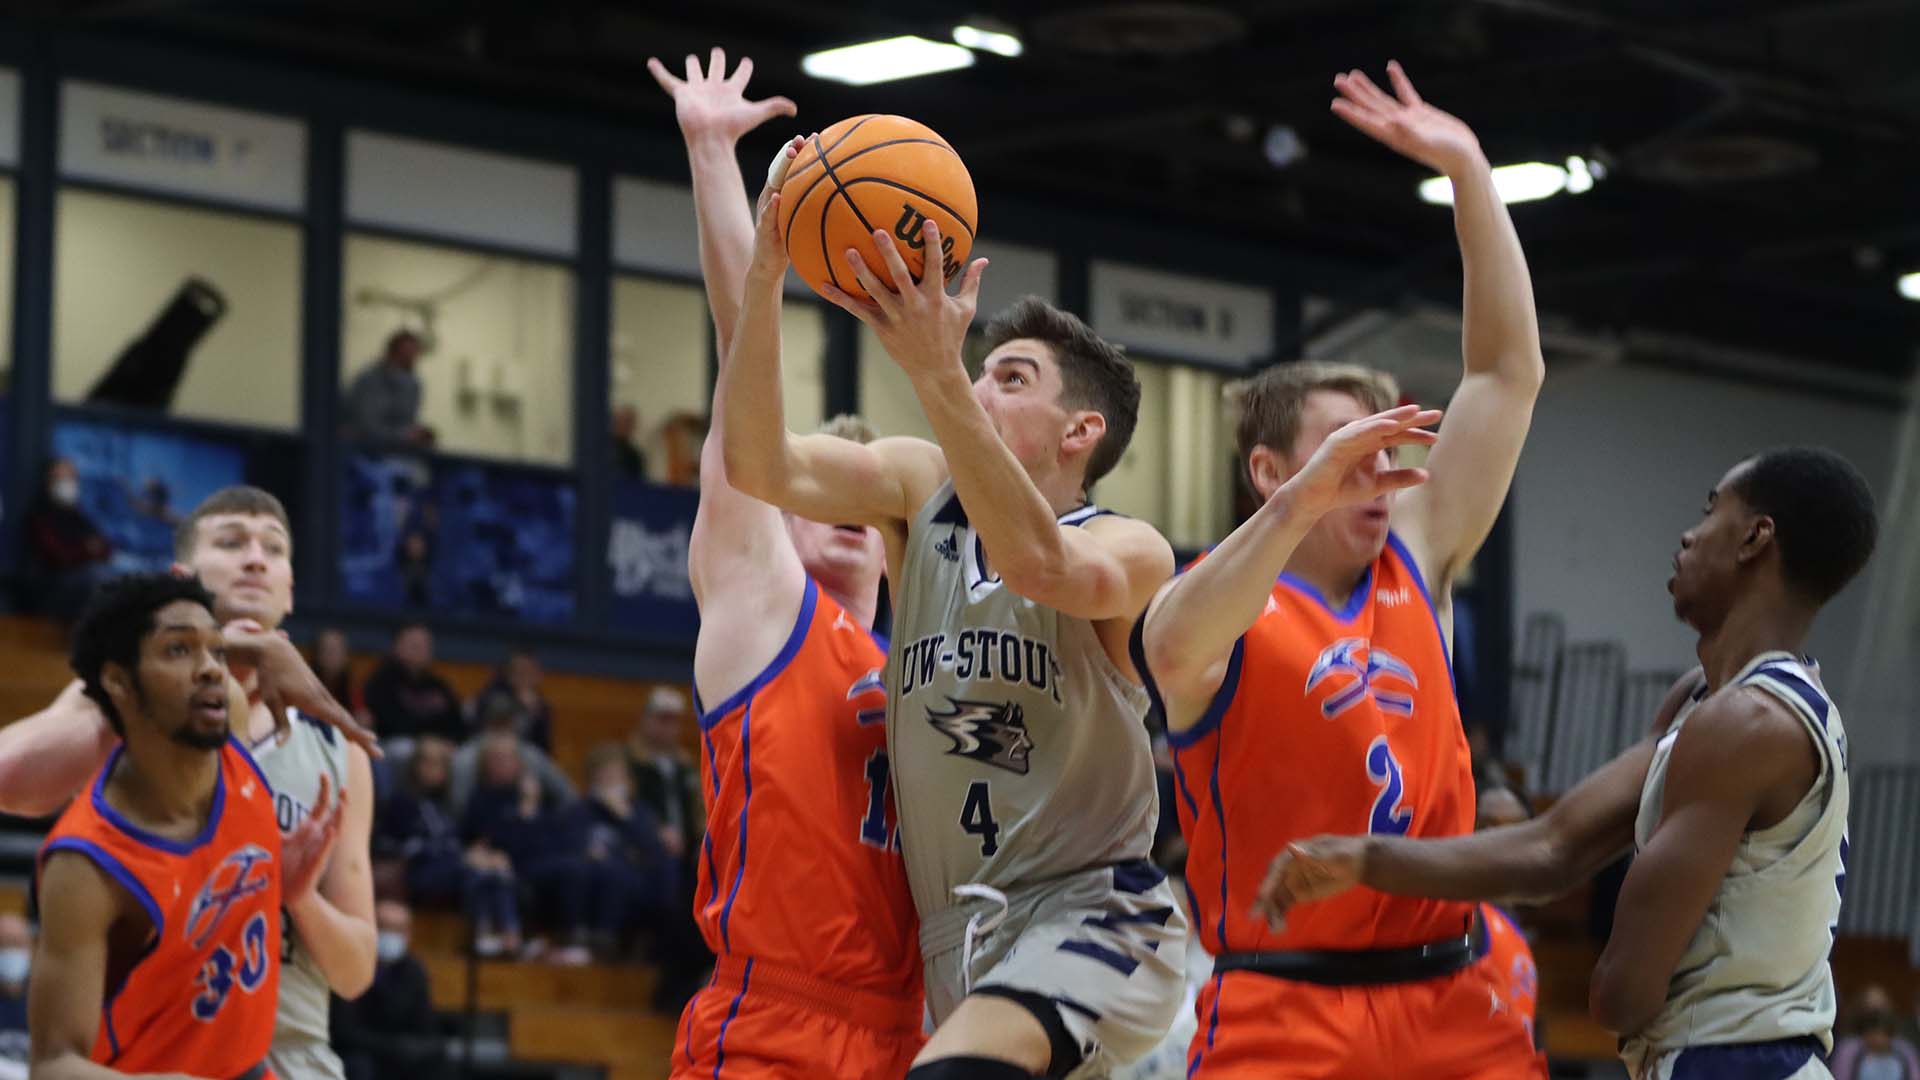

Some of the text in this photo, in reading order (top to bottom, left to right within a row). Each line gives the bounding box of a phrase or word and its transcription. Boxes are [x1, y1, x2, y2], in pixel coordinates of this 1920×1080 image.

[860, 747, 902, 853] 1
[958, 780, 1001, 858] 4
[1365, 734, 1414, 838] 2
[191, 910, 269, 1022] 30
